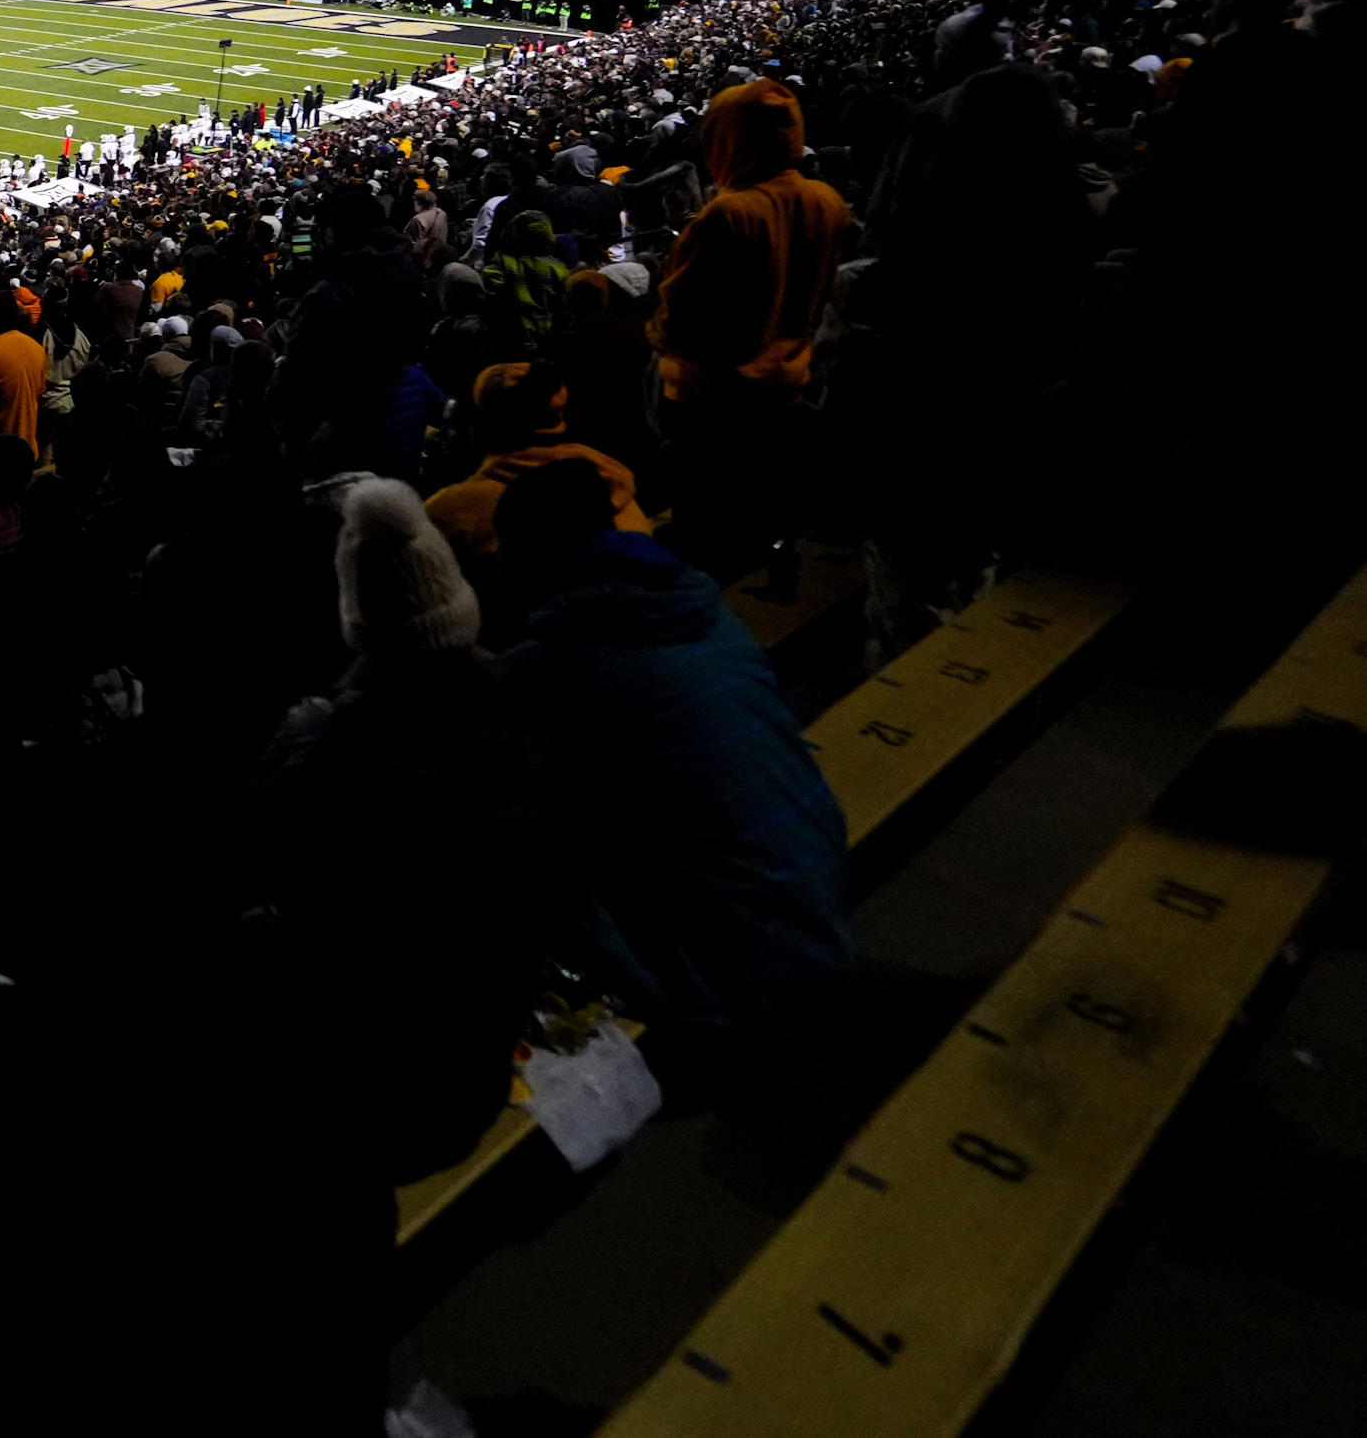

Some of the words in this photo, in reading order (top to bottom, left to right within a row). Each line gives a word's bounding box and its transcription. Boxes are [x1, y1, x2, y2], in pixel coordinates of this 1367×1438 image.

[19, 105, 80, 120] 40
[1154, 878, 1227, 922] 10
[952, 1132, 1031, 1183] 8
